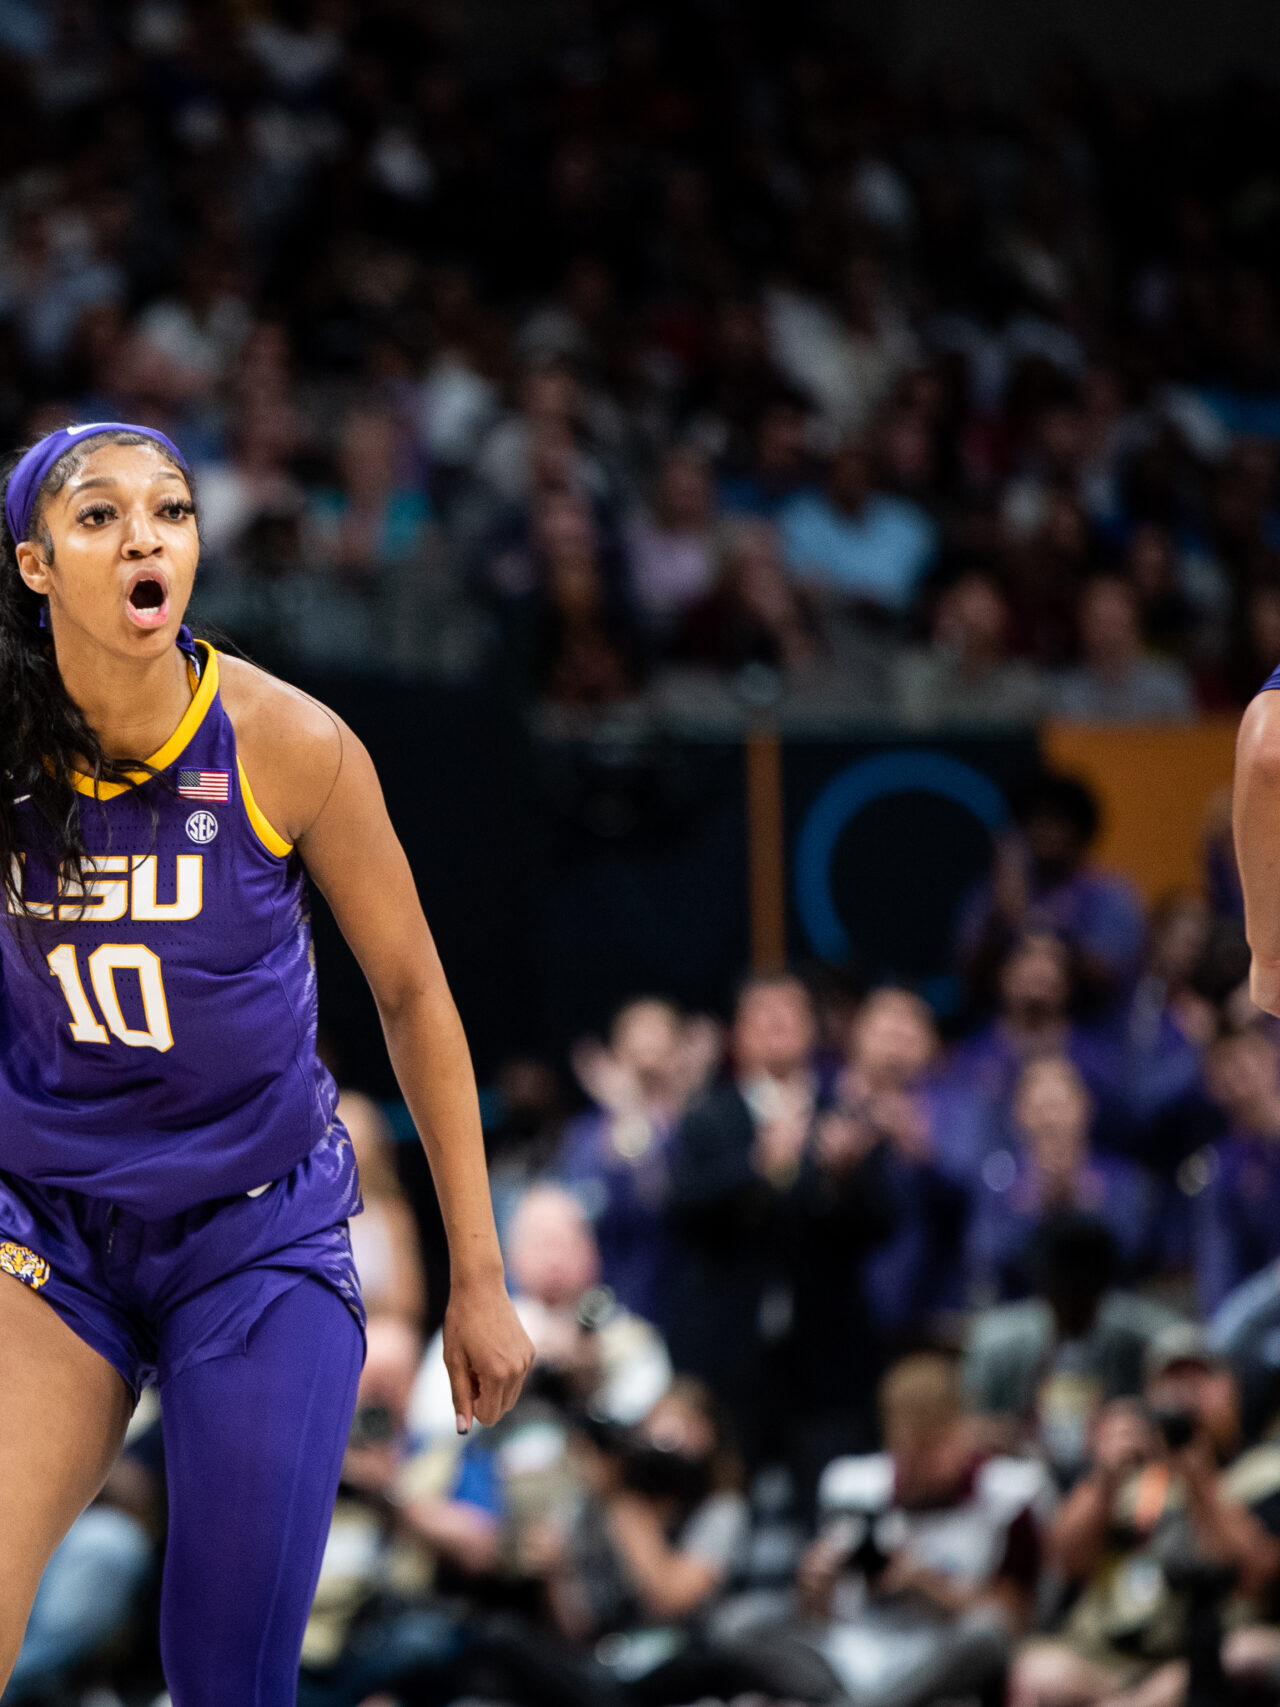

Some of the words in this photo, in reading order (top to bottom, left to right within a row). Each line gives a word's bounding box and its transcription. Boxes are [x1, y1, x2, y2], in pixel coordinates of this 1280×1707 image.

[189, 813, 215, 841] SEC
[6, 852, 204, 921] LSU
[46, 943, 174, 1053] 10
